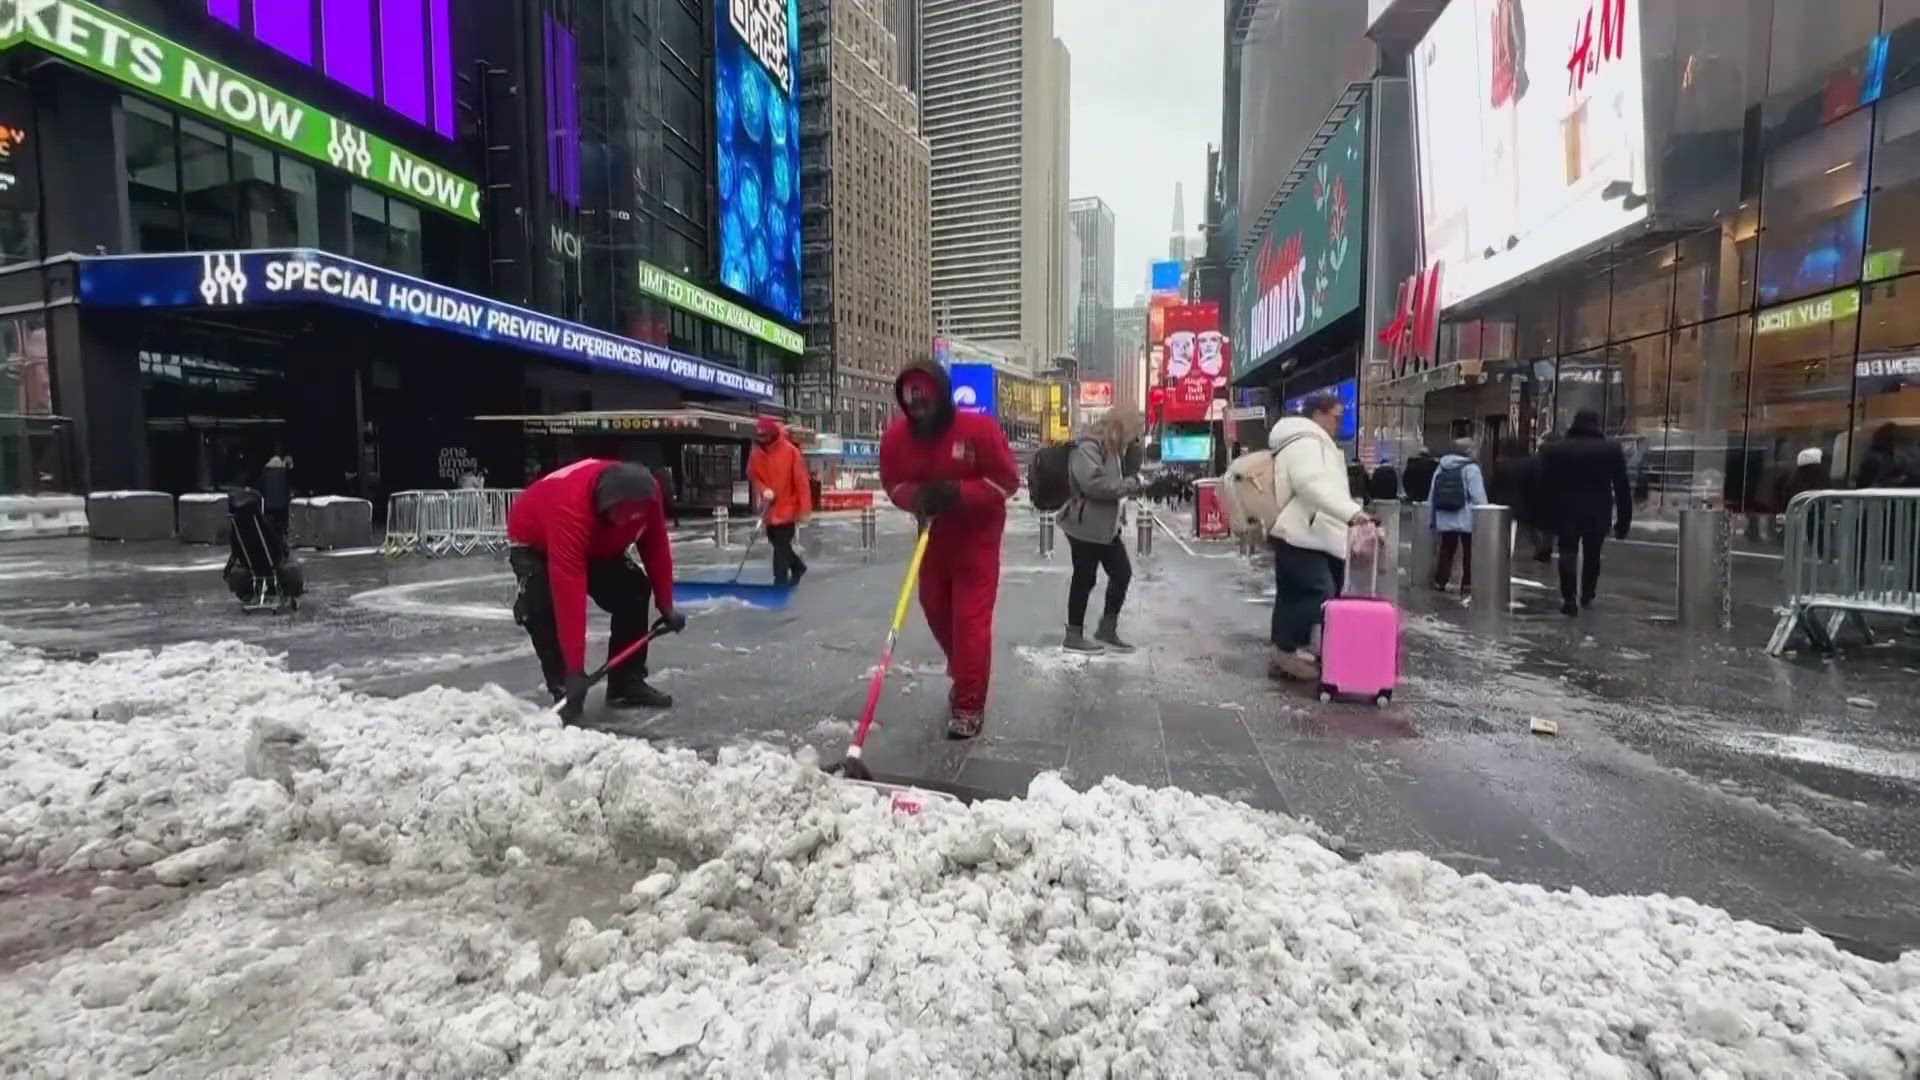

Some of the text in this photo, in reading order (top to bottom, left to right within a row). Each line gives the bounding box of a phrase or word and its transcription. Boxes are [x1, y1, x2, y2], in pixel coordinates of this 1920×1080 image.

[1567, 0, 1626, 96] H&M
[181, 57, 303, 141] NOW
[388, 151, 465, 209] NOW
[265, 261, 382, 306] SPECIAL
[389, 283, 484, 328] HOLIDAY
[487, 309, 561, 346] PREVIEW
[562, 330, 642, 365] EXPERIENCES
[643, 349, 670, 372] NOW
[699, 364, 716, 384] BUY
[639, 263, 683, 302] LIMITED
[686, 287, 724, 319] TICKETS
[727, 304, 766, 334] AVAILABLE
[1251, 255, 1307, 363] HOLIDAYS
